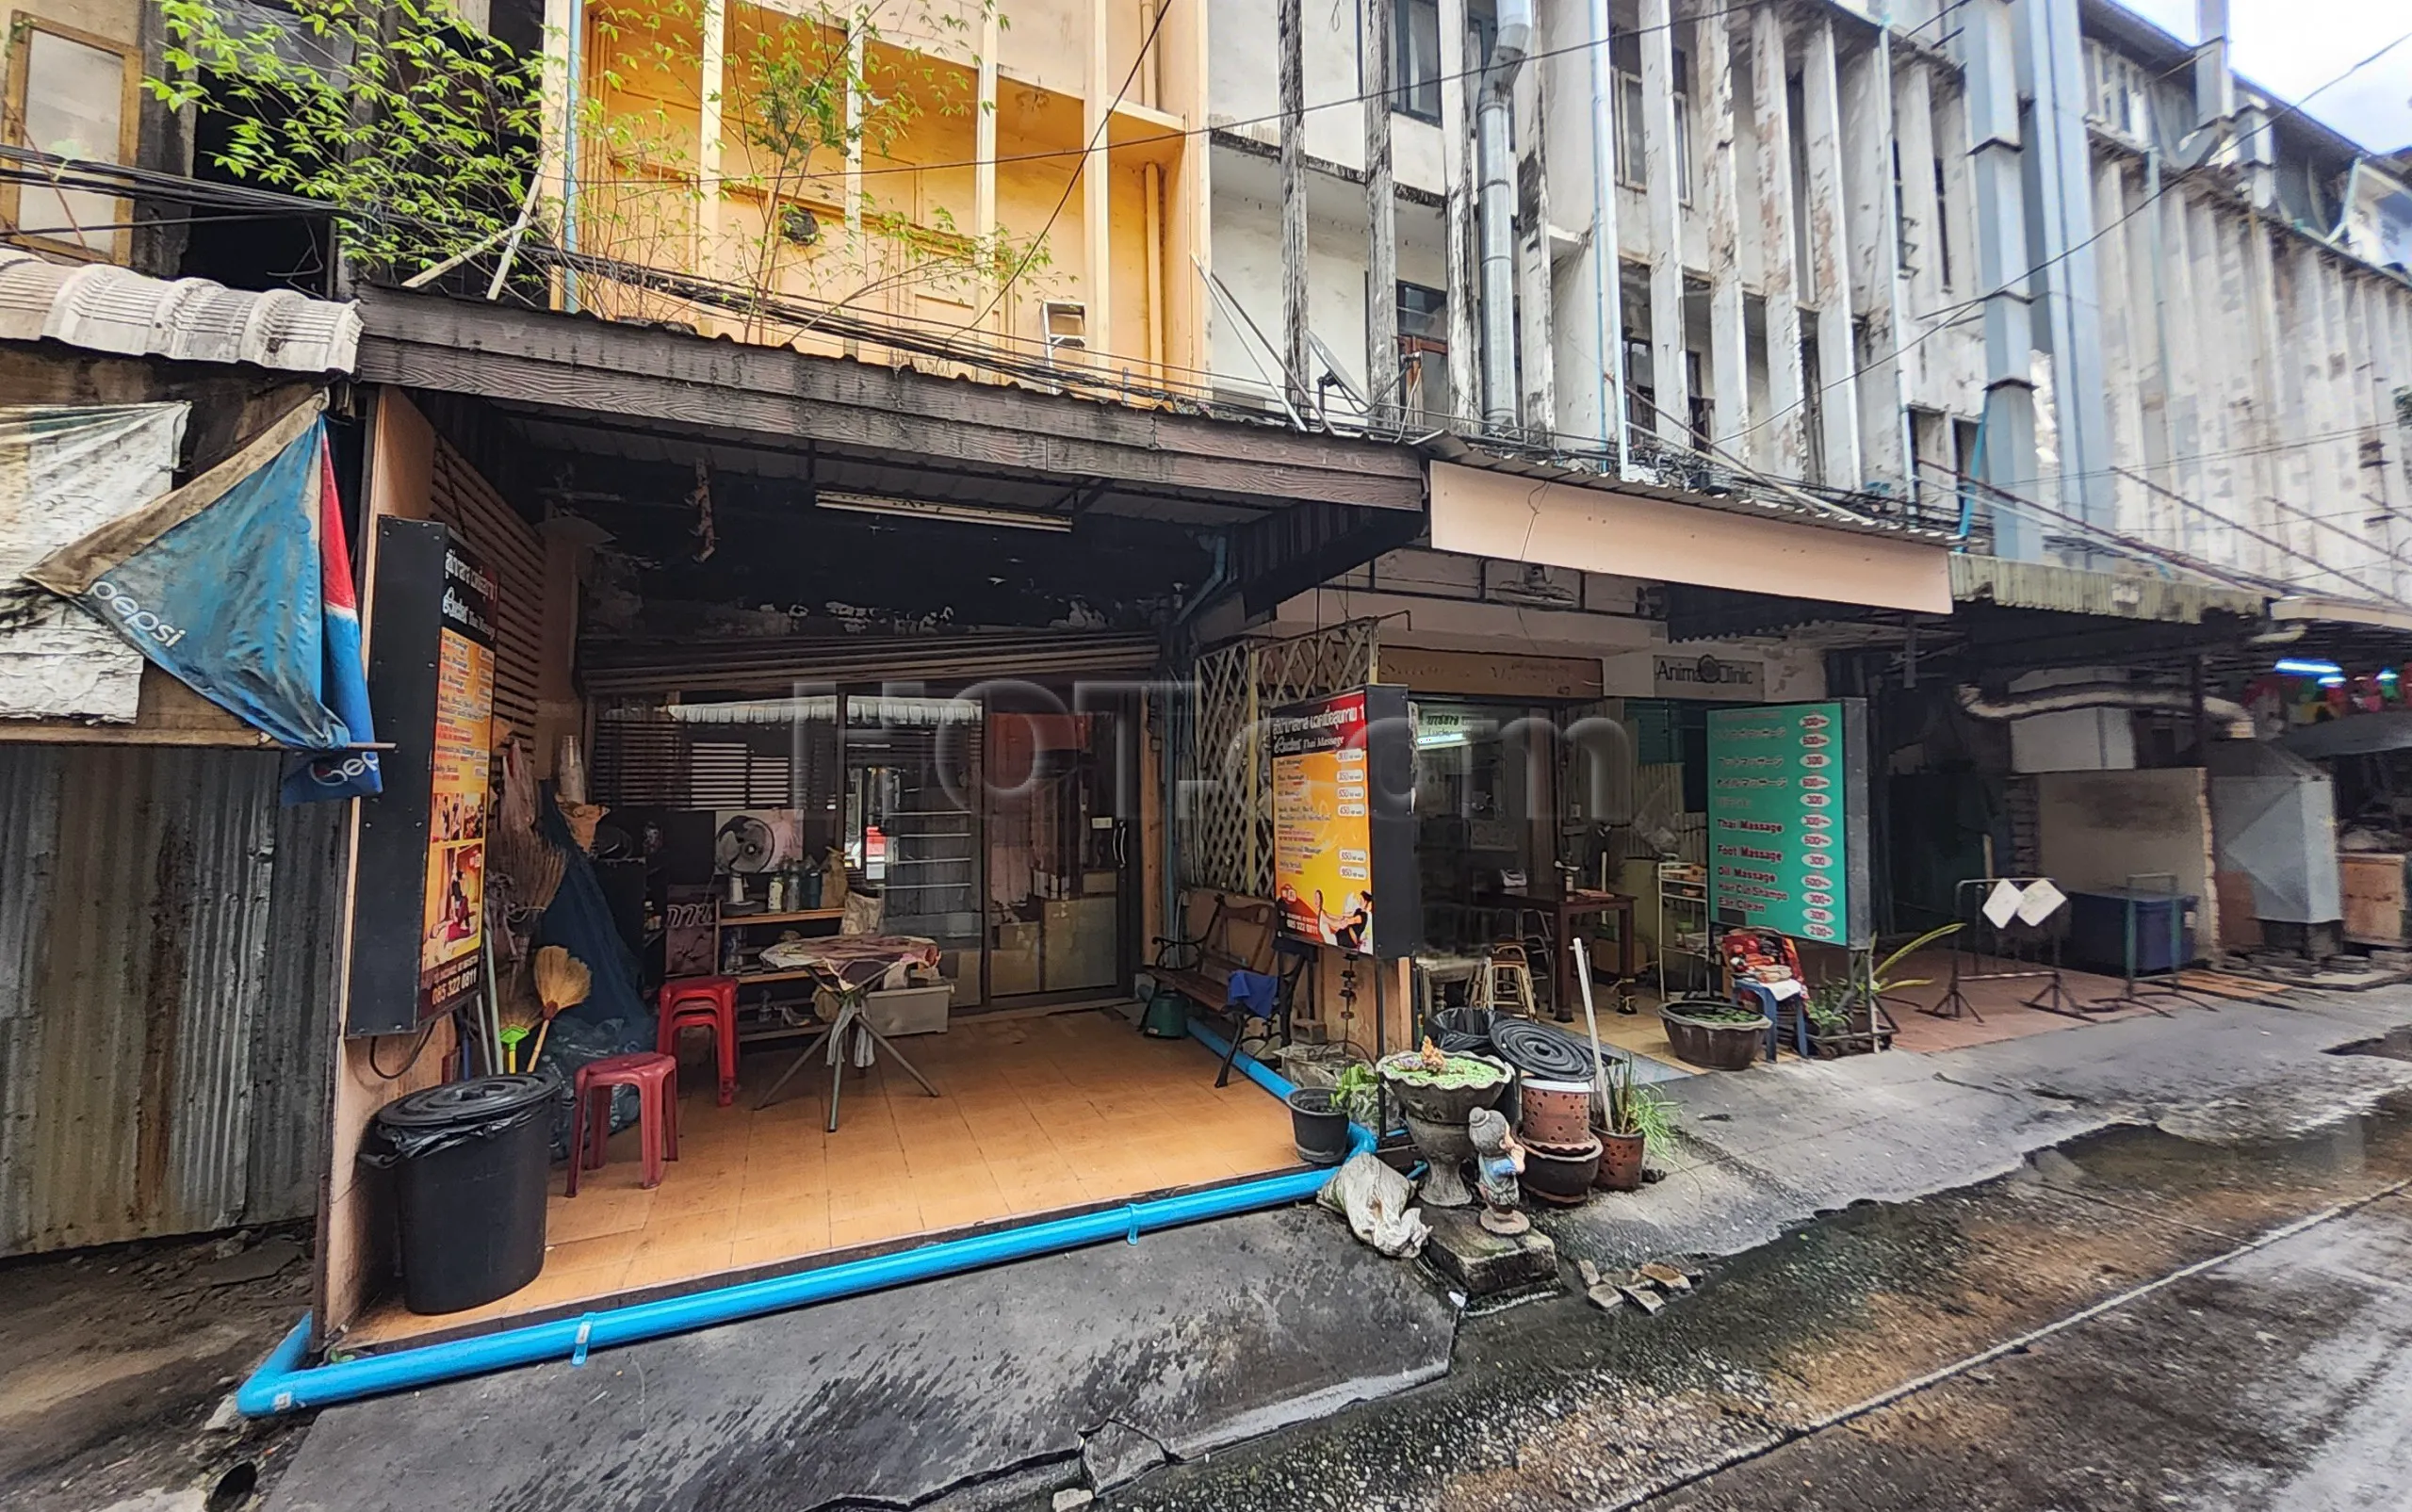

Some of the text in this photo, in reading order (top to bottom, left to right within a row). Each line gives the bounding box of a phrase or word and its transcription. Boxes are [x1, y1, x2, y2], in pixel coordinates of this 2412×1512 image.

[92, 580, 186, 648] pepsi
[1718, 819, 1783, 834] Thai Massage
[1718, 844, 1783, 863] Foot Massage
[1718, 866, 1777, 884] Oil Massage
[1736, 900, 1766, 913] Clean
